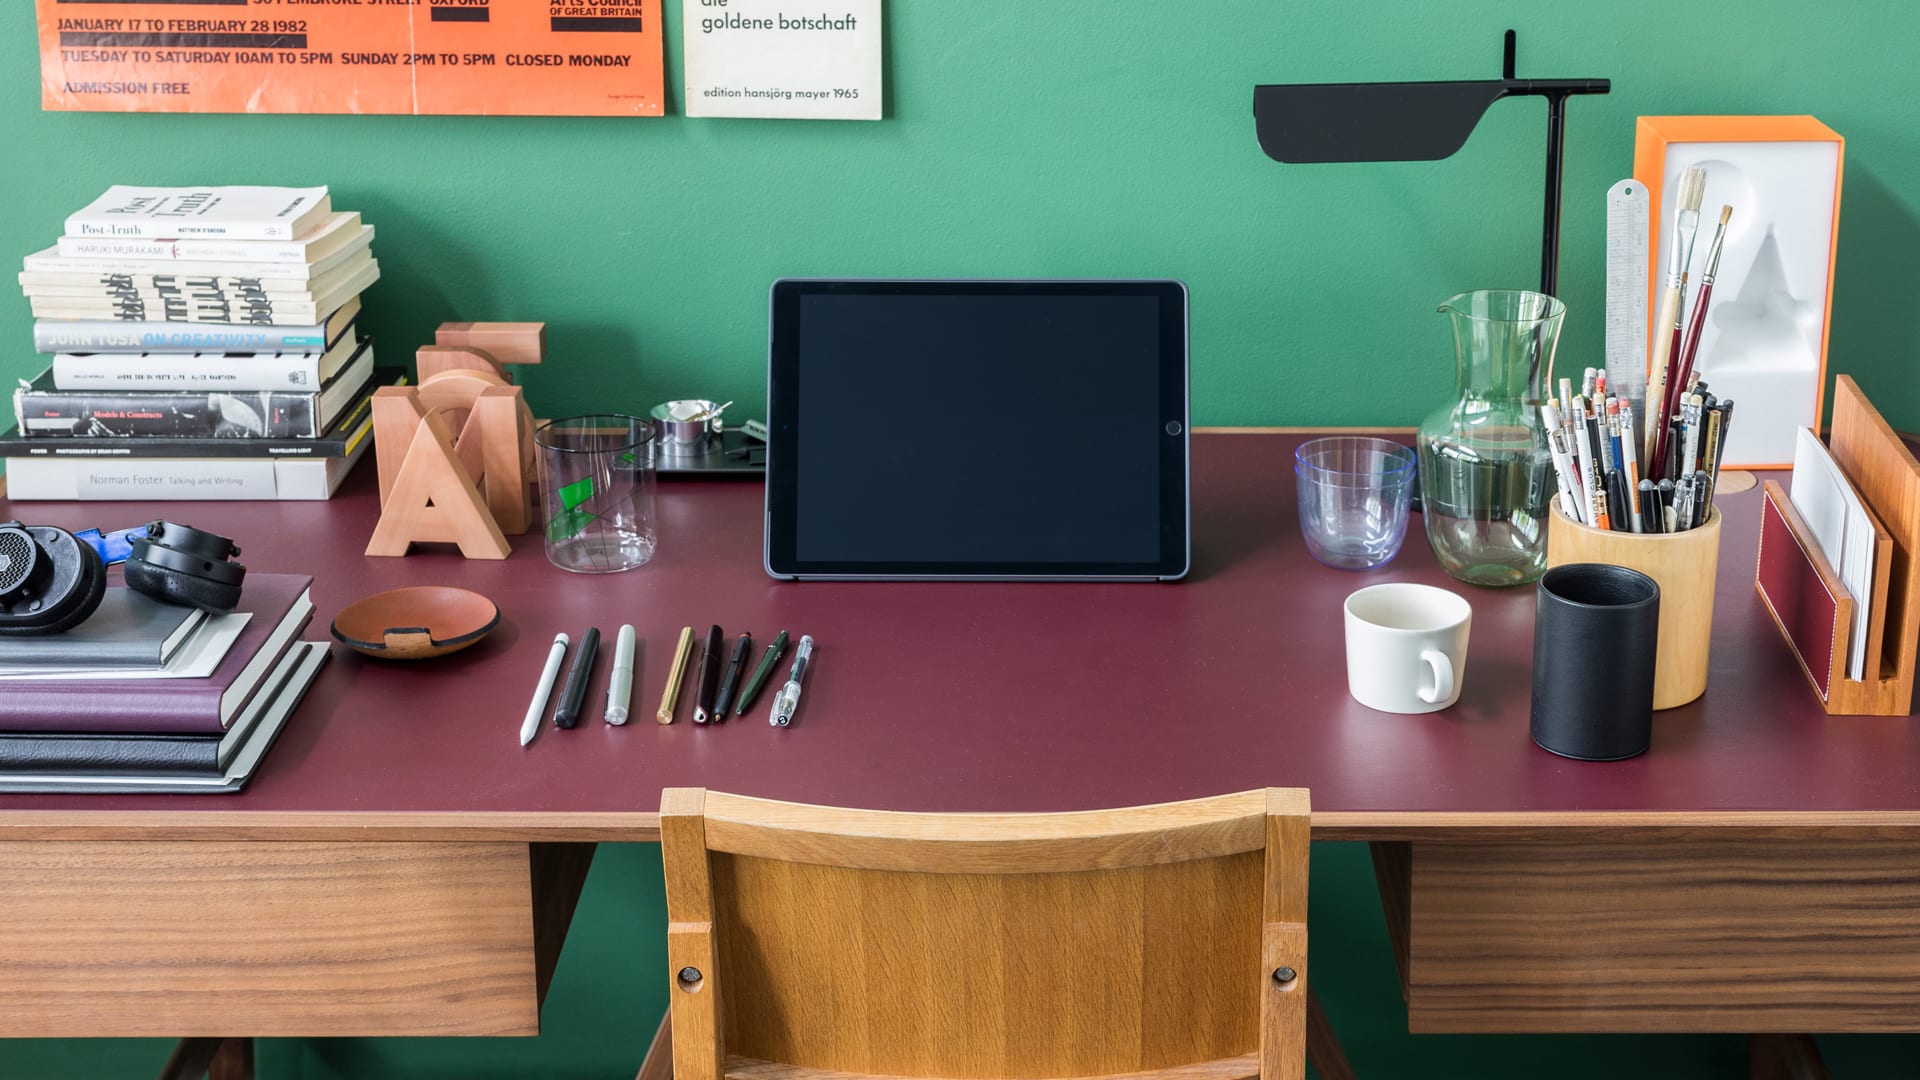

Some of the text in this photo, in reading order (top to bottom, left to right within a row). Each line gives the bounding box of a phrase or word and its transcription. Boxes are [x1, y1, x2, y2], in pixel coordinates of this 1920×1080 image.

[549, 7, 642, 16] OF GREAT BRITAIN
[57, 19, 308, 33] JANUARY 17 TO FEBRUARY 28 1982
[702, 12, 857, 34] goldene botschaft
[62, 50, 631, 67] TUESDAY TO SATURDAY 10AM TO 5PM SUNDAY 2PM TO 5PM CLOSED MONDAY
[63, 81, 190, 95] ADMISSION FREE
[703, 87, 859, 100] edition hansjörg mayer 1965
[77, 245, 164, 255] HARUKI MURAKAMI
[143, 333, 167, 347] ON
[171, 333, 266, 348] CREATIVITY
[94, 410, 118, 418] Models
[90, 474, 163, 485] Norman Foster
[169, 477, 243, 486] Talking and Writing
